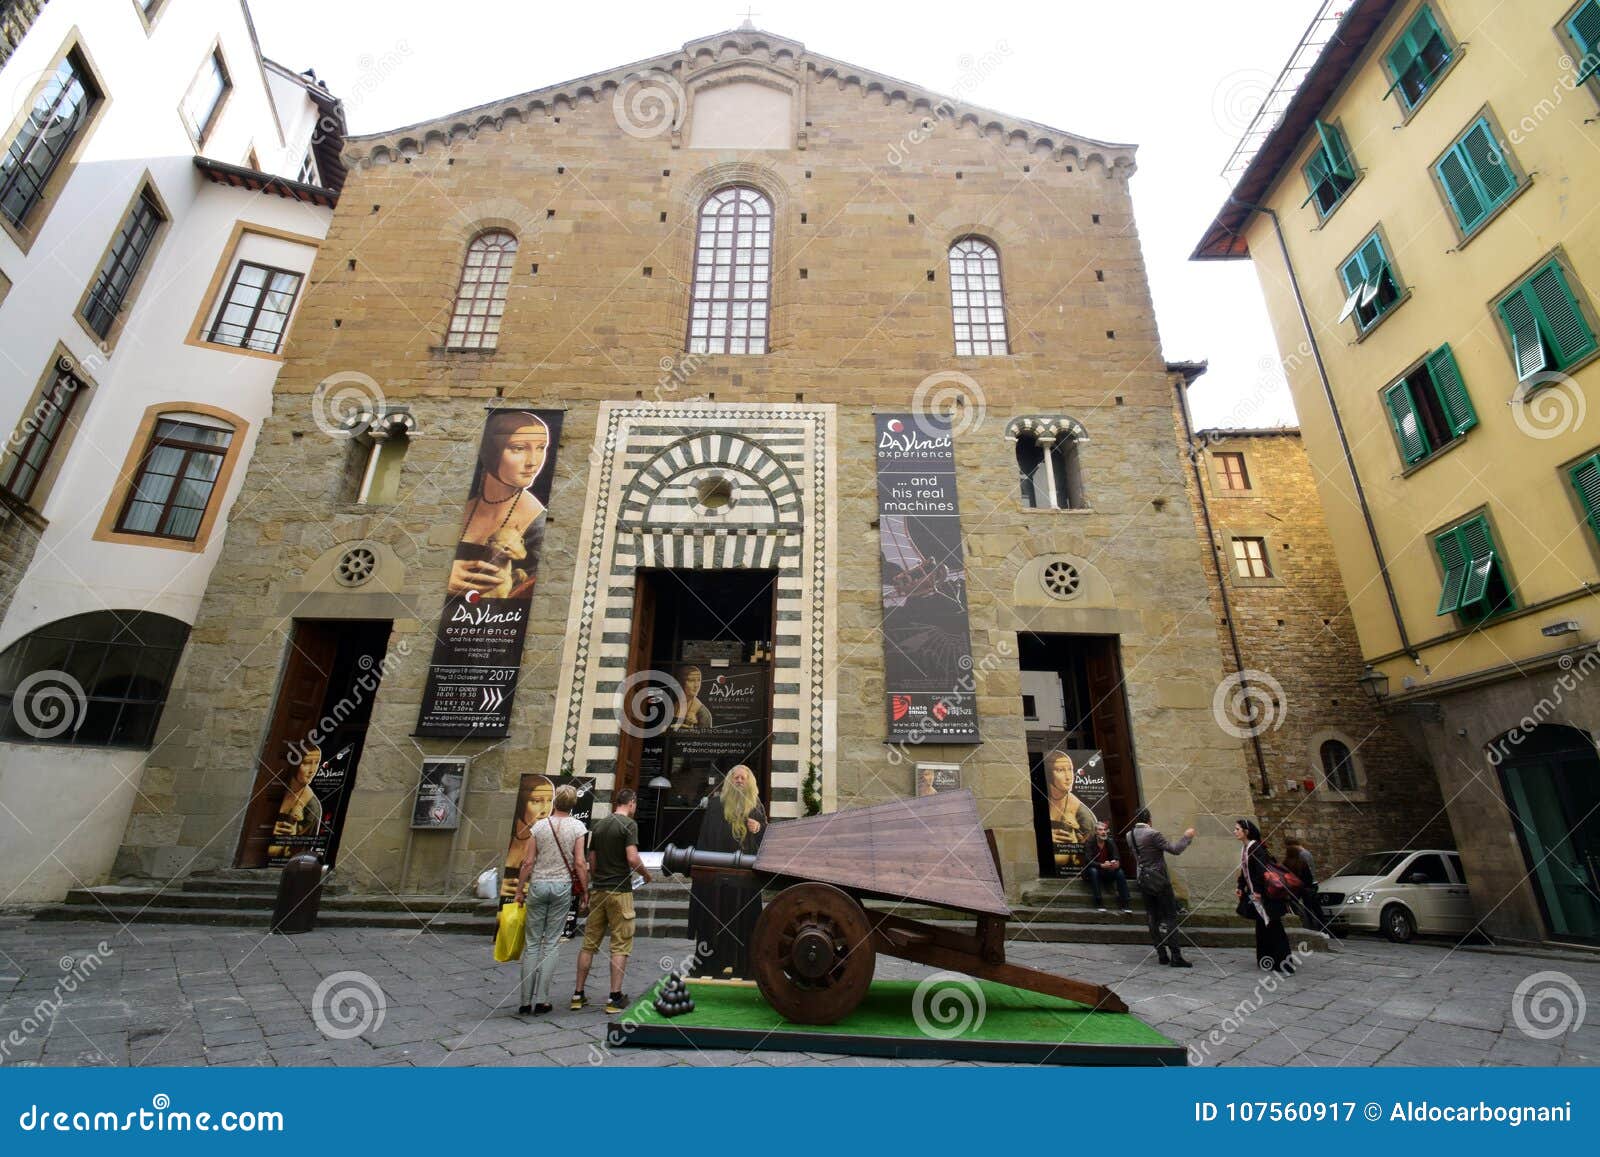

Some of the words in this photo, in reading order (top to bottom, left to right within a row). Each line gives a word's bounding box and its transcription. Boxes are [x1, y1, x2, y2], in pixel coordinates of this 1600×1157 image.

[878, 451, 952, 459] experience
[911, 476, 937, 486] and
[892, 488, 912, 498] his
[917, 488, 944, 498] real
[884, 501, 954, 511] machines
[446, 627, 517, 636] experience
[488, 670, 515, 681] 2017
